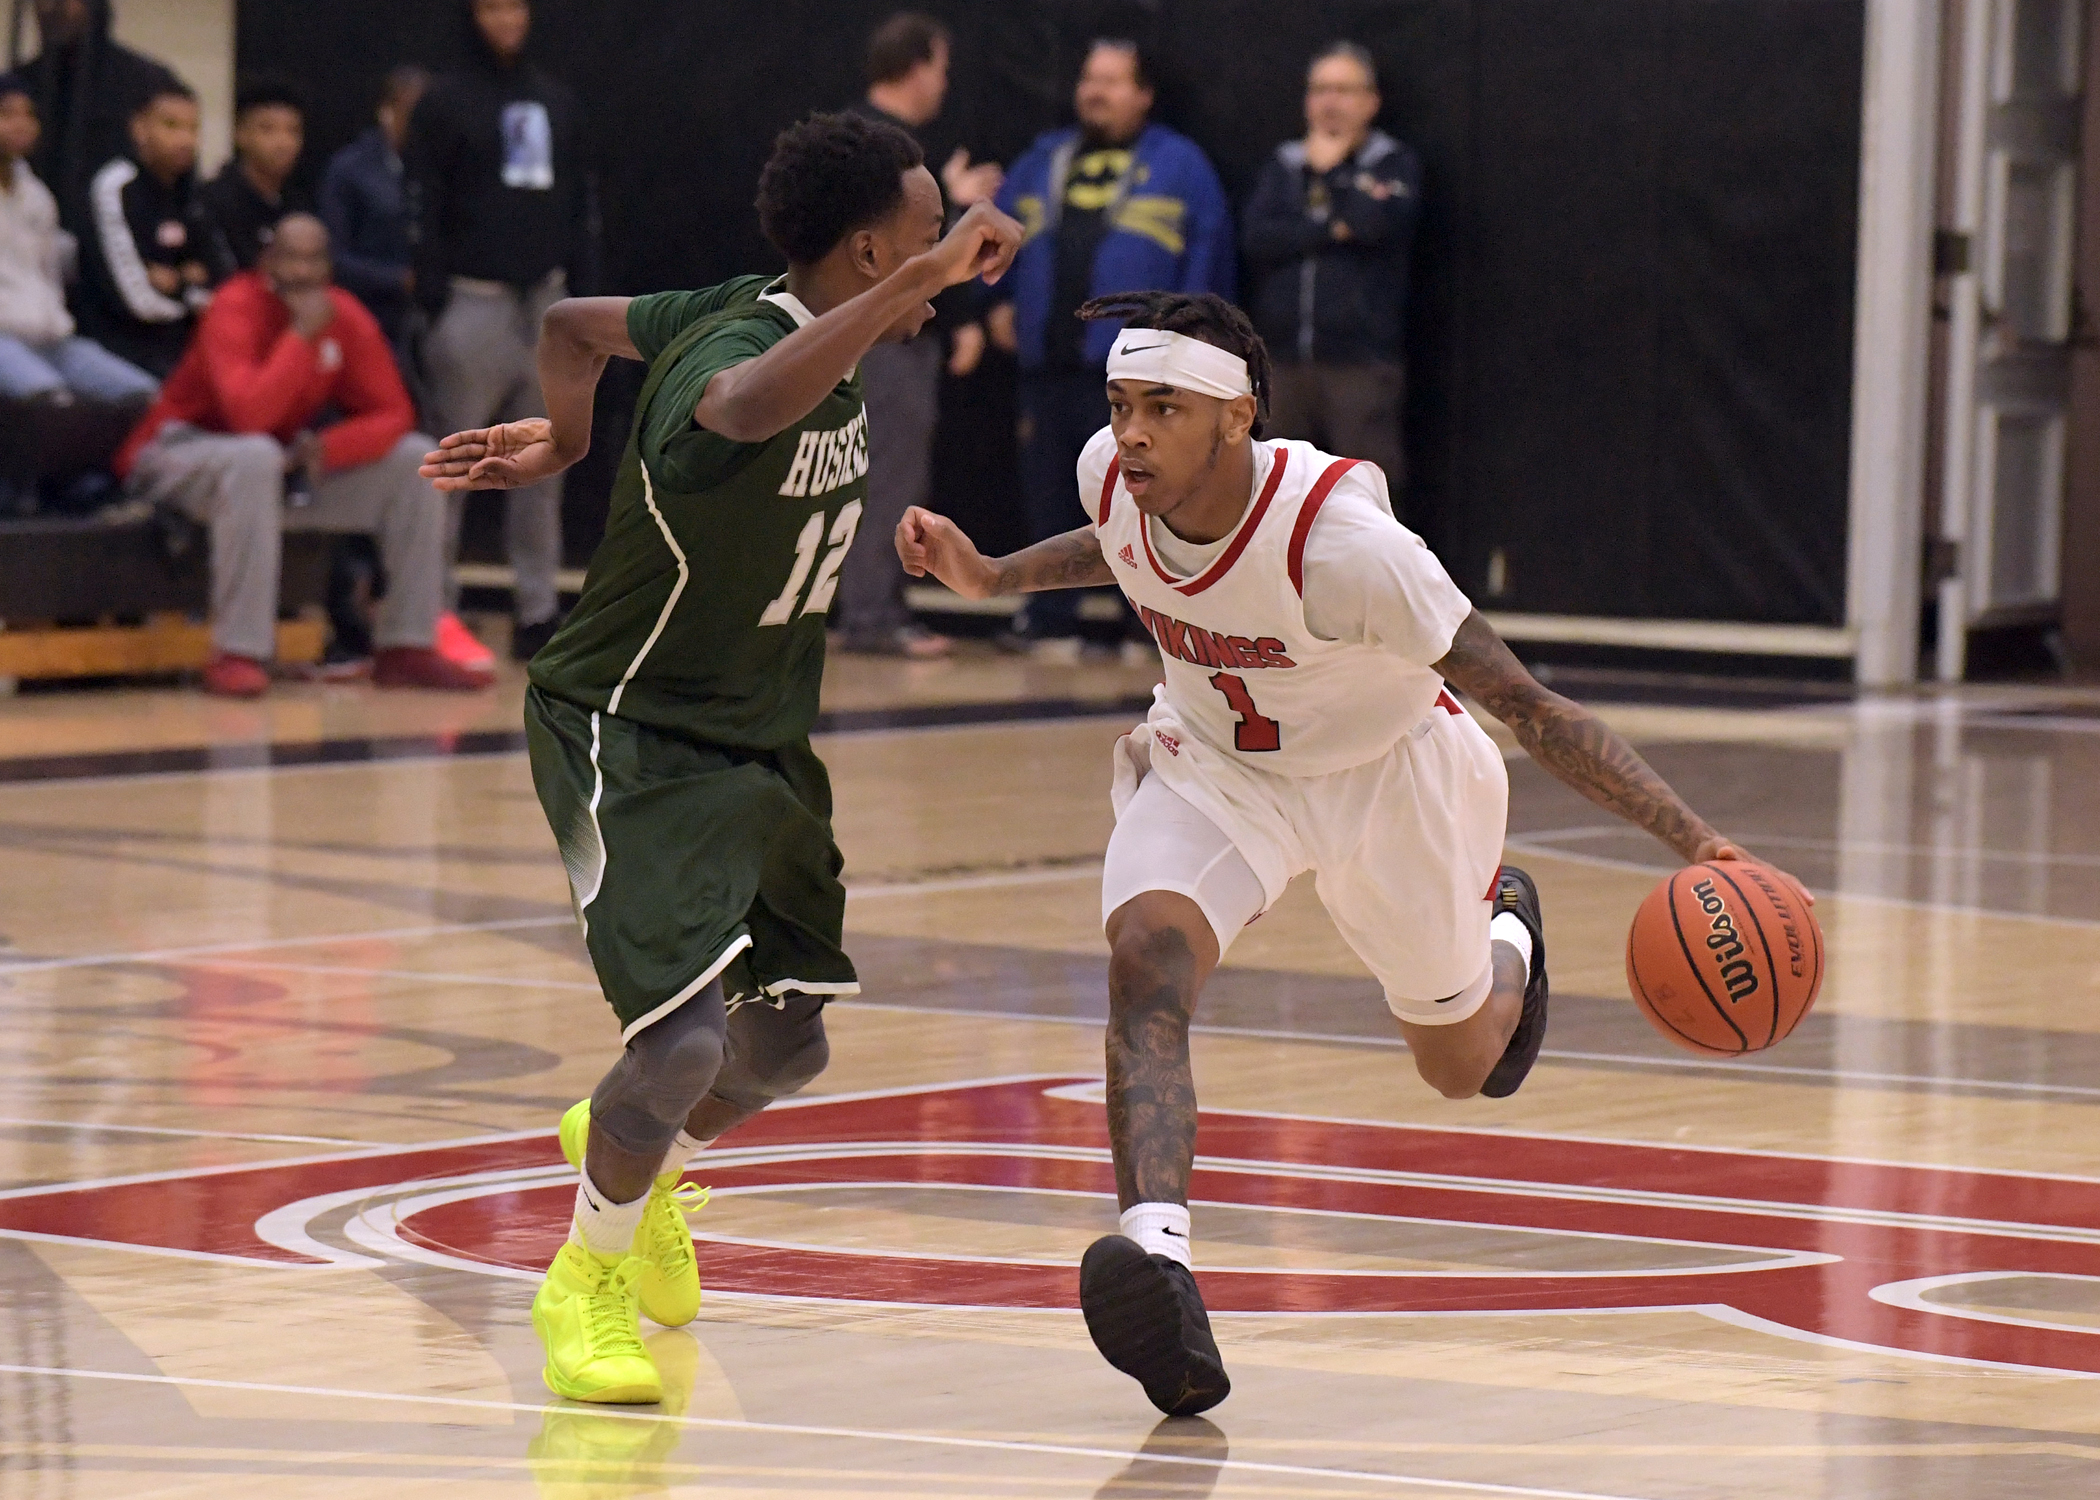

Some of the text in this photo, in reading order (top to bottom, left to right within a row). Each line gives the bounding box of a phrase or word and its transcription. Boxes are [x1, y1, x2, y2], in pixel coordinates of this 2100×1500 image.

[757, 497, 863, 627] 12
[1155, 730, 1179, 757] adidas
[1208, 671, 1281, 752] 1
[1691, 877, 1759, 1004] Wilson
